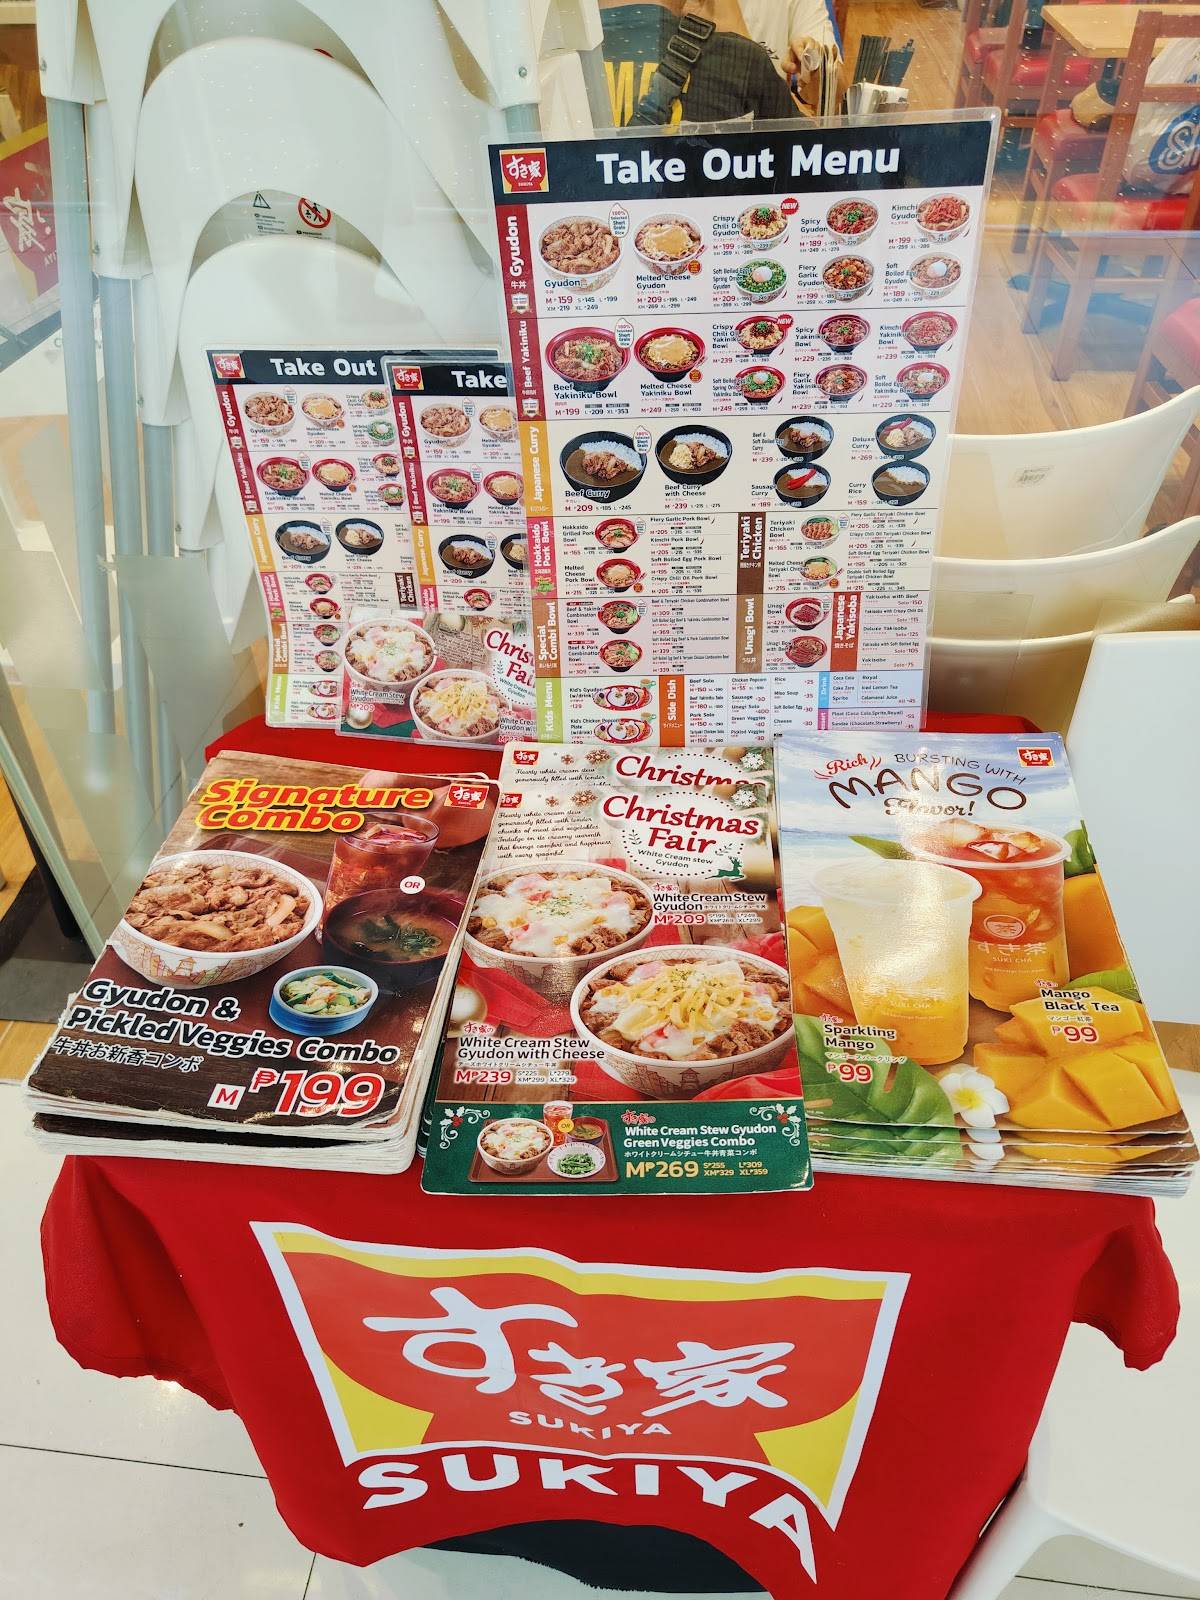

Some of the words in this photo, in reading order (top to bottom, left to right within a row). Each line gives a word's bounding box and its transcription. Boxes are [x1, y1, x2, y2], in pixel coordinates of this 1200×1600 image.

[595, 150, 686, 184] Take
[703, 147, 775, 181] Out
[791, 143, 900, 177] Menu
[781, 202, 799, 210] NEW
[891, 204, 918, 212] Kimchi
[712, 215, 735, 224] Crispy
[801, 218, 821, 227] Spicy
[890, 212, 920, 221] Gyudon
[800, 226, 829, 235] Gyudon
[506, 216, 525, 276] Gyudon
[798, 264, 817, 272] Fiery
[544, 279, 581, 289] Gyudon
[636, 282, 666, 290] Gyudon
[797, 279, 825, 287] Gyudon
[712, 324, 734, 332] Crispy
[519, 320, 530, 362] Yakiniku
[270, 358, 325, 376] Take
[333, 359, 378, 376] Out
[524, 365, 534, 388] Beef
[451, 369, 507, 389] Take
[553, 383, 575, 391] Beef
[554, 391, 595, 399] Yakiniku
[221, 391, 235, 427] Gyudon
[399, 402, 410, 437] Gyudon
[529, 426, 540, 453] Curry
[532, 457, 544, 502] Japanese
[564, 490, 584, 498] Beef
[585, 489, 610, 498] Curry
[534, 524, 542, 567] Hokkaido
[740, 516, 751, 560] Teriyaki
[752, 517, 762, 560] Chicken
[543, 545, 551, 567] Pork
[547, 602, 556, 625] Bowl
[745, 598, 754, 623] Bowl
[834, 595, 845, 641] Japanese
[846, 595, 857, 641] Yakisoba
[538, 625, 546, 661] Special
[548, 630, 557, 661] Combi
[744, 625, 755, 655] Unagi
[544, 682, 553, 708] Menu
[667, 679, 676, 700] Dish
[667, 702, 676, 721] Side
[500, 724, 524, 732] Gyudon
[545, 712, 553, 732] Kids
[826, 754, 868, 775] Rich
[894, 752, 980, 770] BURSTING
[985, 763, 1027, 785] WITH
[202, 779, 434, 808] Signature
[828, 767, 1028, 810] MANGO
[602, 795, 761, 836] Christmas
[883, 797, 976, 817] Flavor!
[197, 804, 365, 832] Combo
[647, 828, 717, 853] Fair
[638, 849, 663, 858] White
[664, 852, 692, 862] Cream
[655, 858, 690, 869] Gyudon
[404, 880, 421, 890] OR
[653, 894, 690, 902] White
[691, 894, 733, 902] Cream
[733, 893, 766, 902] Stew
[653, 902, 703, 912] Gyudon
[84, 979, 210, 1018] Gyudon
[215, 997, 241, 1022] &
[1041, 988, 1090, 1000] Mango
[1044, 1000, 1085, 1011] Black
[1091, 1001, 1120, 1012] Tea
[66, 1006, 179, 1041] Pickled
[178, 1022, 291, 1058] Veggies
[297, 1038, 400, 1065] Combo
[824, 1024, 896, 1039] Sparkling
[460, 1037, 501, 1048] White
[504, 1037, 551, 1048] Cream
[552, 1037, 590, 1048] Stew
[825, 1037, 875, 1050] Mango
[52, 1036, 204, 1073] 牛丼お新香コンボ
[458, 1049, 515, 1061] Gyudon
[517, 1049, 550, 1059] with
[552, 1049, 605, 1059] Cheese
[214, 1089, 240, 1106] M
[625, 1126, 658, 1136] White
[660, 1125, 698, 1136] Cream
[700, 1125, 729, 1135] Stew
[731, 1124, 777, 1136] Gyudon
[623, 1138, 659, 1148] Green
[661, 1137, 709, 1150] Veggies
[710, 1136, 756, 1147] Combo
[363, 1287, 795, 1418] すき家
[508, 1411, 672, 1439] SUKIYA
[357, 1454, 817, 1584] SUKIYA
